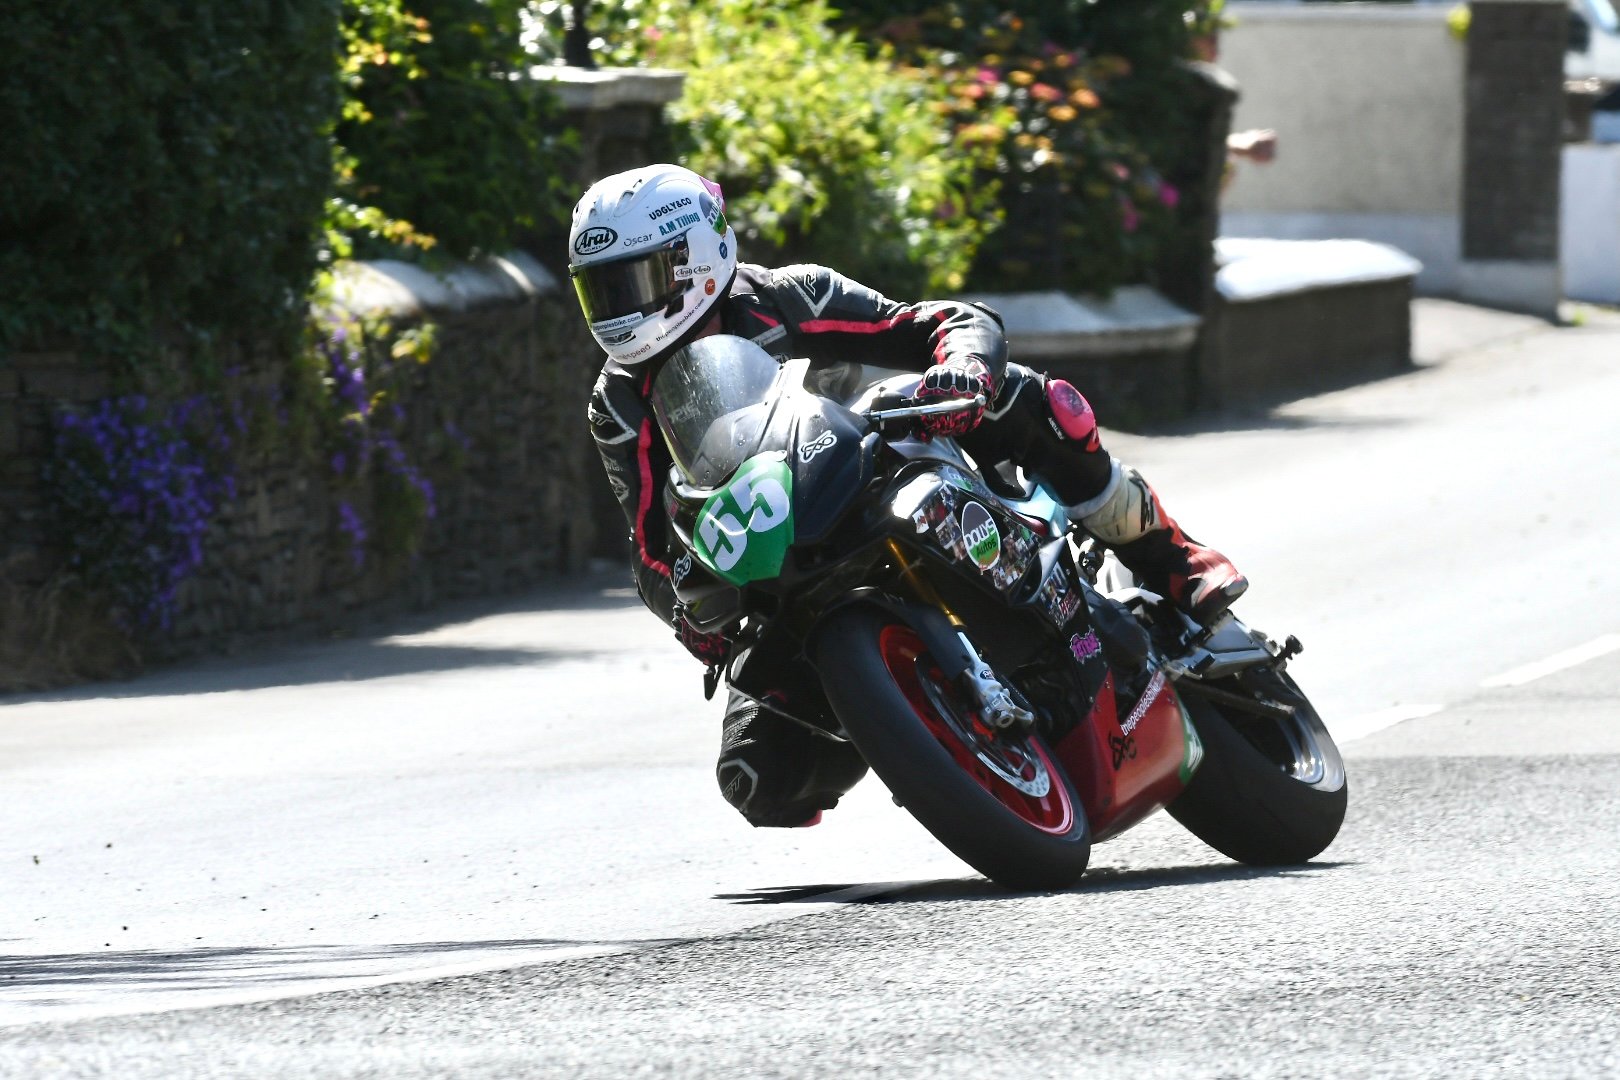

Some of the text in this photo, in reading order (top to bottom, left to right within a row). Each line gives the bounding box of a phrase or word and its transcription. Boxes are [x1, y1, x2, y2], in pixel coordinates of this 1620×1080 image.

[576, 229, 611, 250] Arai
[623, 233, 653, 247] Oscar
[698, 467, 790, 572] 55
[965, 517, 996, 551] DOLLYS
[976, 538, 997, 557] Autos
